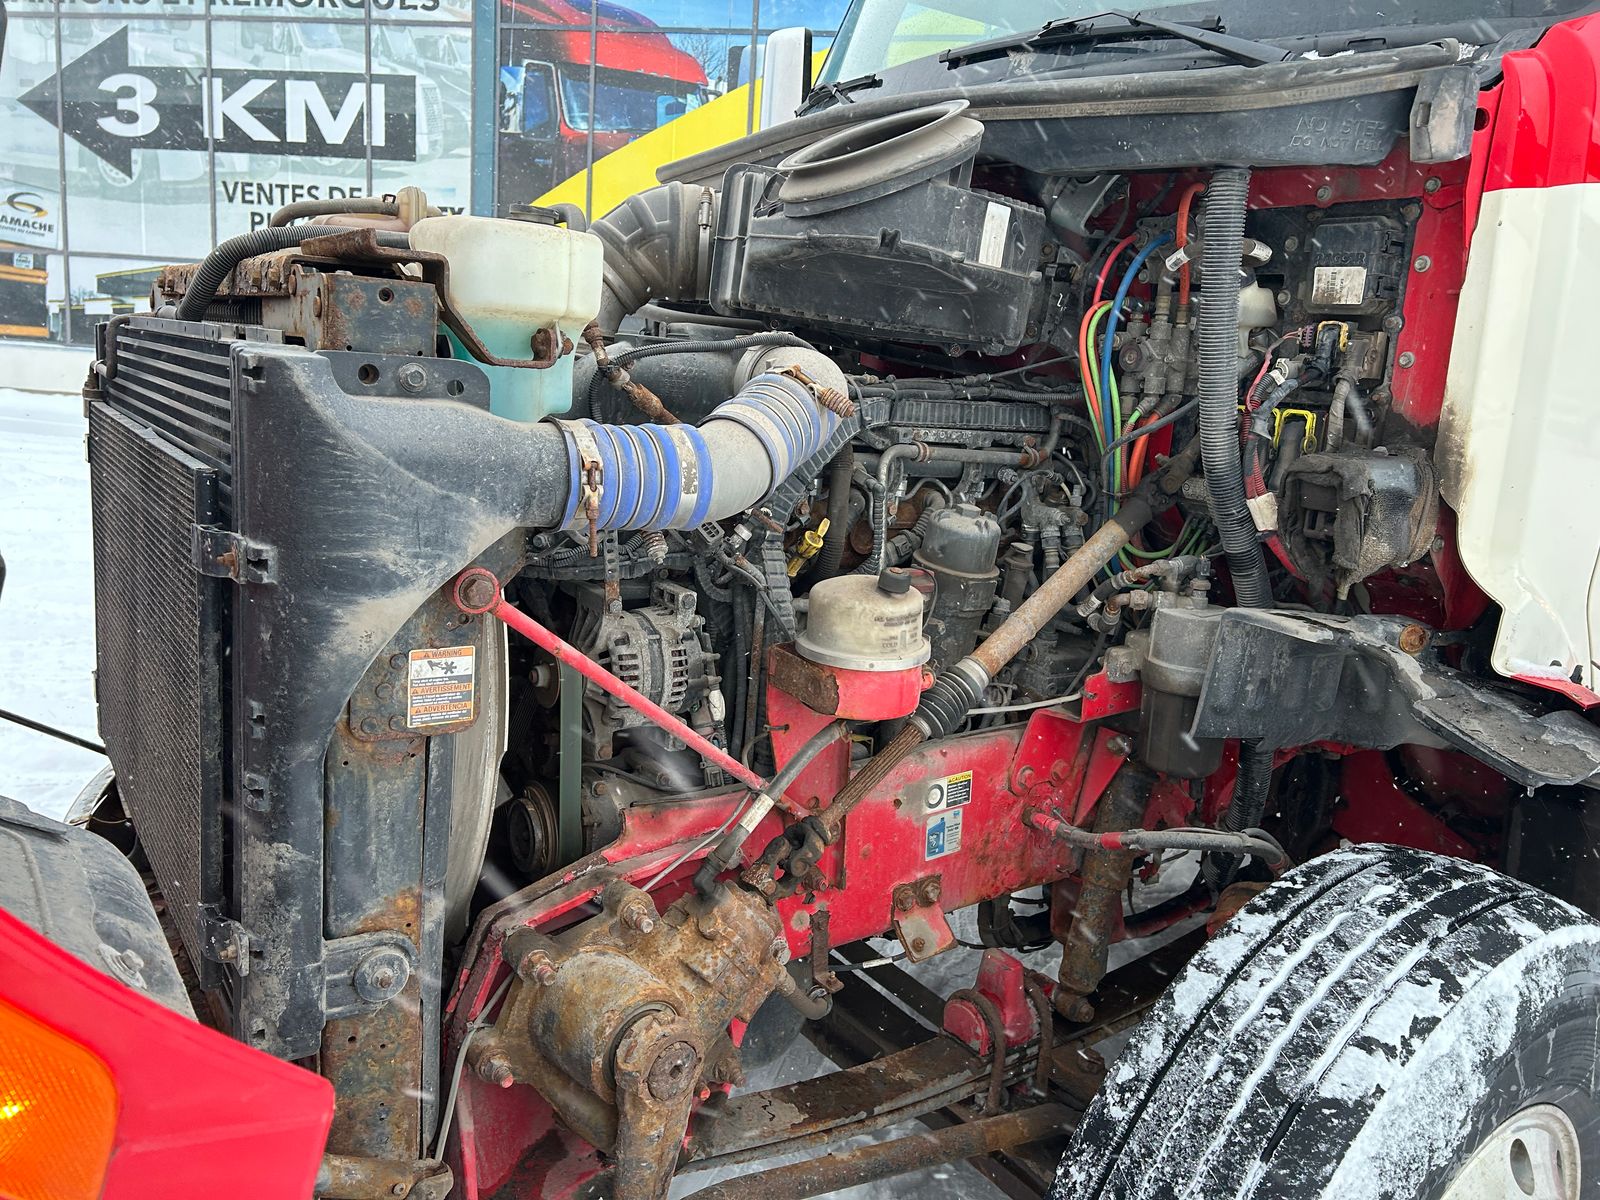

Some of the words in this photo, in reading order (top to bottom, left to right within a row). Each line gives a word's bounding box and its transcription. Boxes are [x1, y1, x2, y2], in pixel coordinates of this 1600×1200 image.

[97, 73, 160, 137] 3
[201, 77, 386, 147] KM
[1296, 115, 1327, 133] NO
[1341, 118, 1385, 137] STEP
[1289, 134, 1312, 148] DO
[1320, 136, 1350, 151] NOT
[221, 180, 320, 206] VENTES
[431, 650, 462, 658] WARNING
[420, 683, 471, 694] AVERTISSEMENT
[423, 702, 468, 713] ADVERTENCIA
